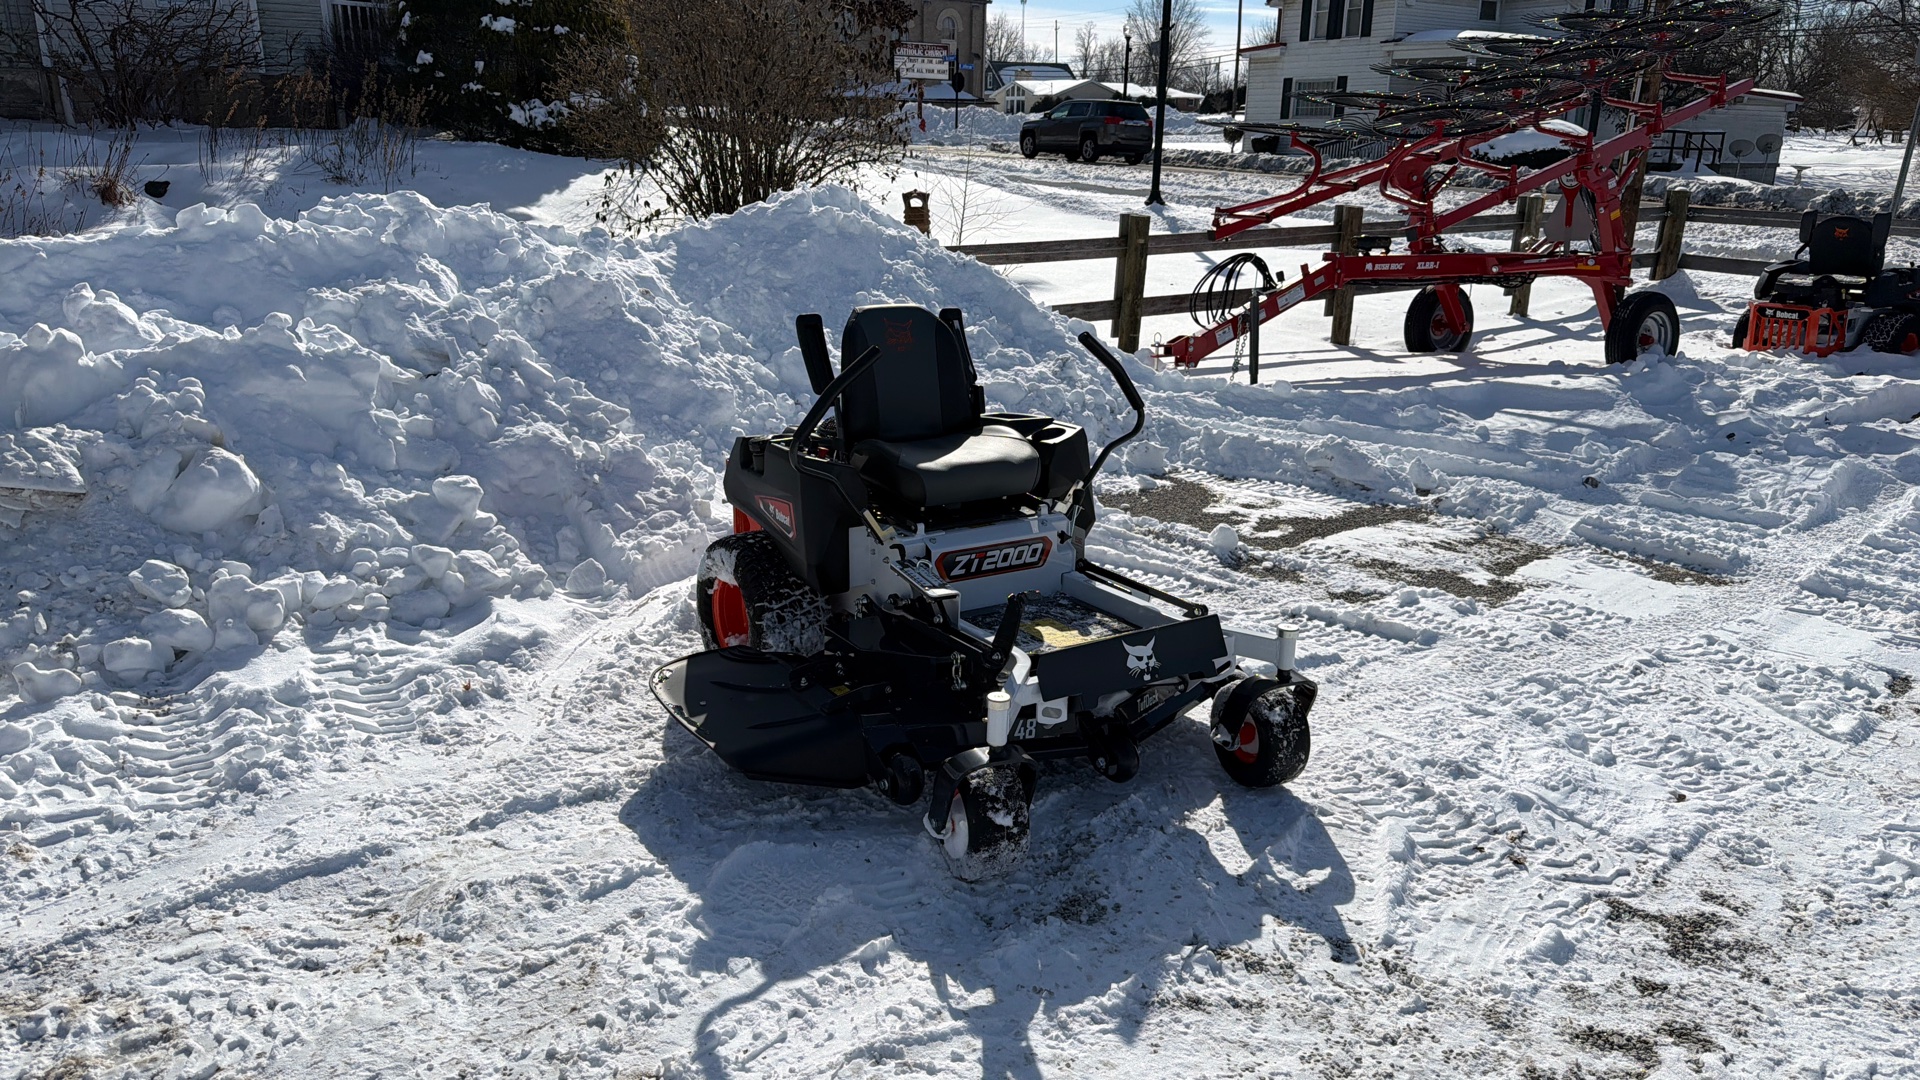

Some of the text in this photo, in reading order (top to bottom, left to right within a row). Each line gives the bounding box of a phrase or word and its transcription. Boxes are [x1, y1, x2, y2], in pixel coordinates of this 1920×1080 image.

[896, 47, 924, 56] CATHOLIC
[1374, 262, 1404, 271] BUSH HOG
[1776, 310, 1799, 319] Bobcat
[950, 543, 1044, 576] ZT2000
[1013, 718, 1037, 740] 48
